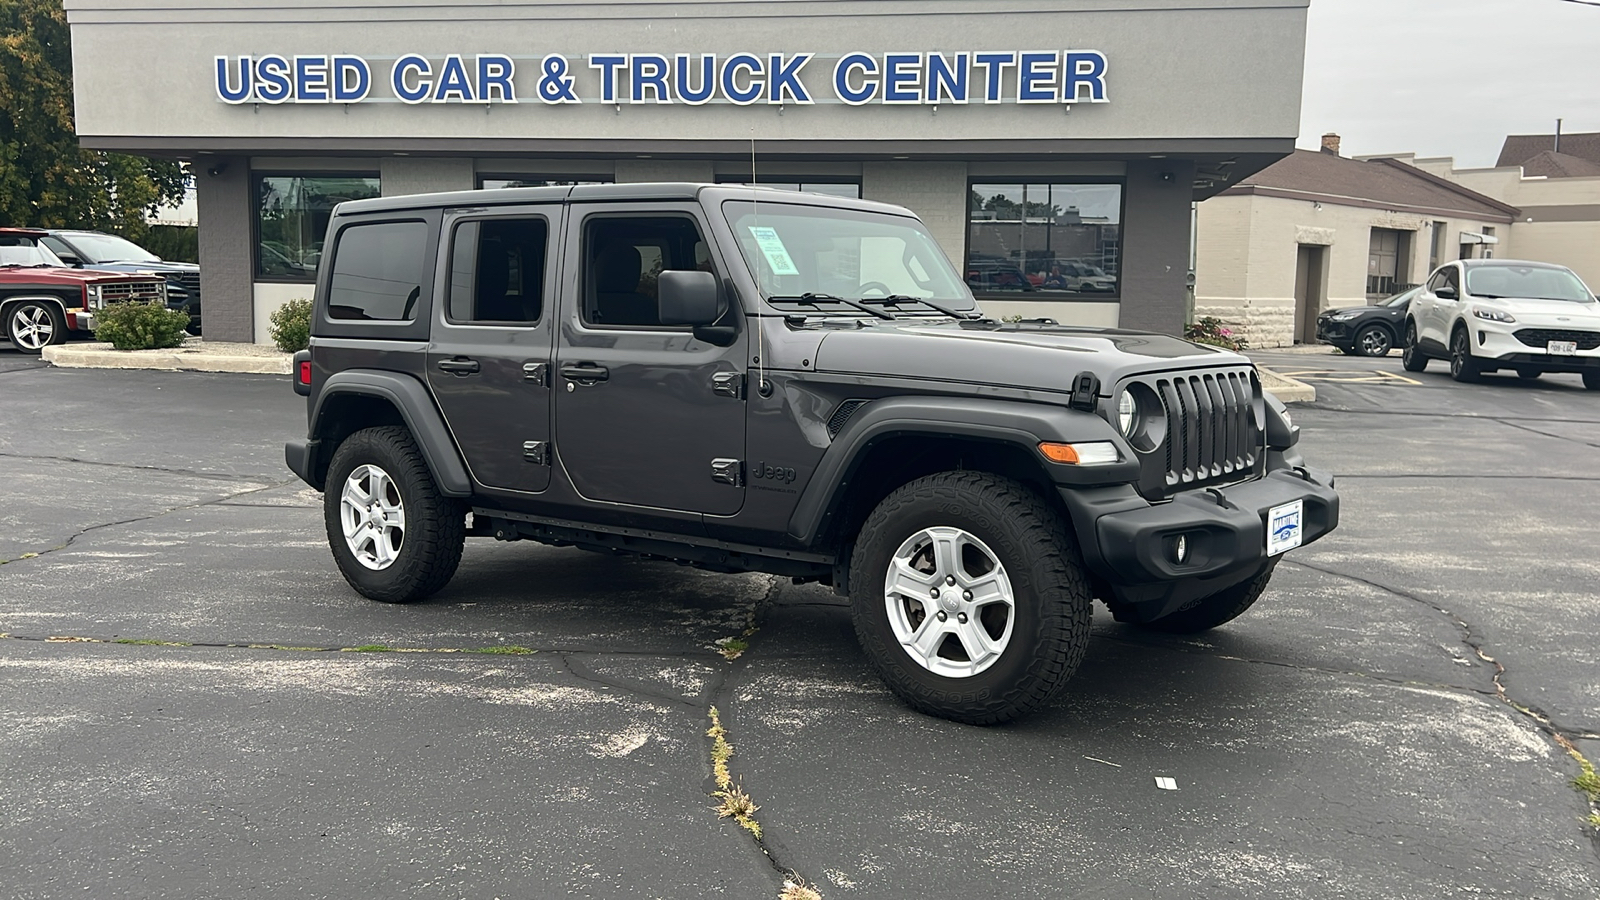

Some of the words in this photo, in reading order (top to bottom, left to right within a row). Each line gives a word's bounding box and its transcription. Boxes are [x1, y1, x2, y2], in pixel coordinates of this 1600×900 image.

[214, 54, 371, 105] USED
[390, 53, 519, 105] CAR
[536, 53, 582, 105] &
[588, 52, 815, 106] TRUCK
[832, 49, 1110, 106] CENTER
[753, 461, 796, 485] Jeep
[936, 502, 1030, 588] YOKOHAMA
[872, 636, 991, 704] GEOLANDAR
